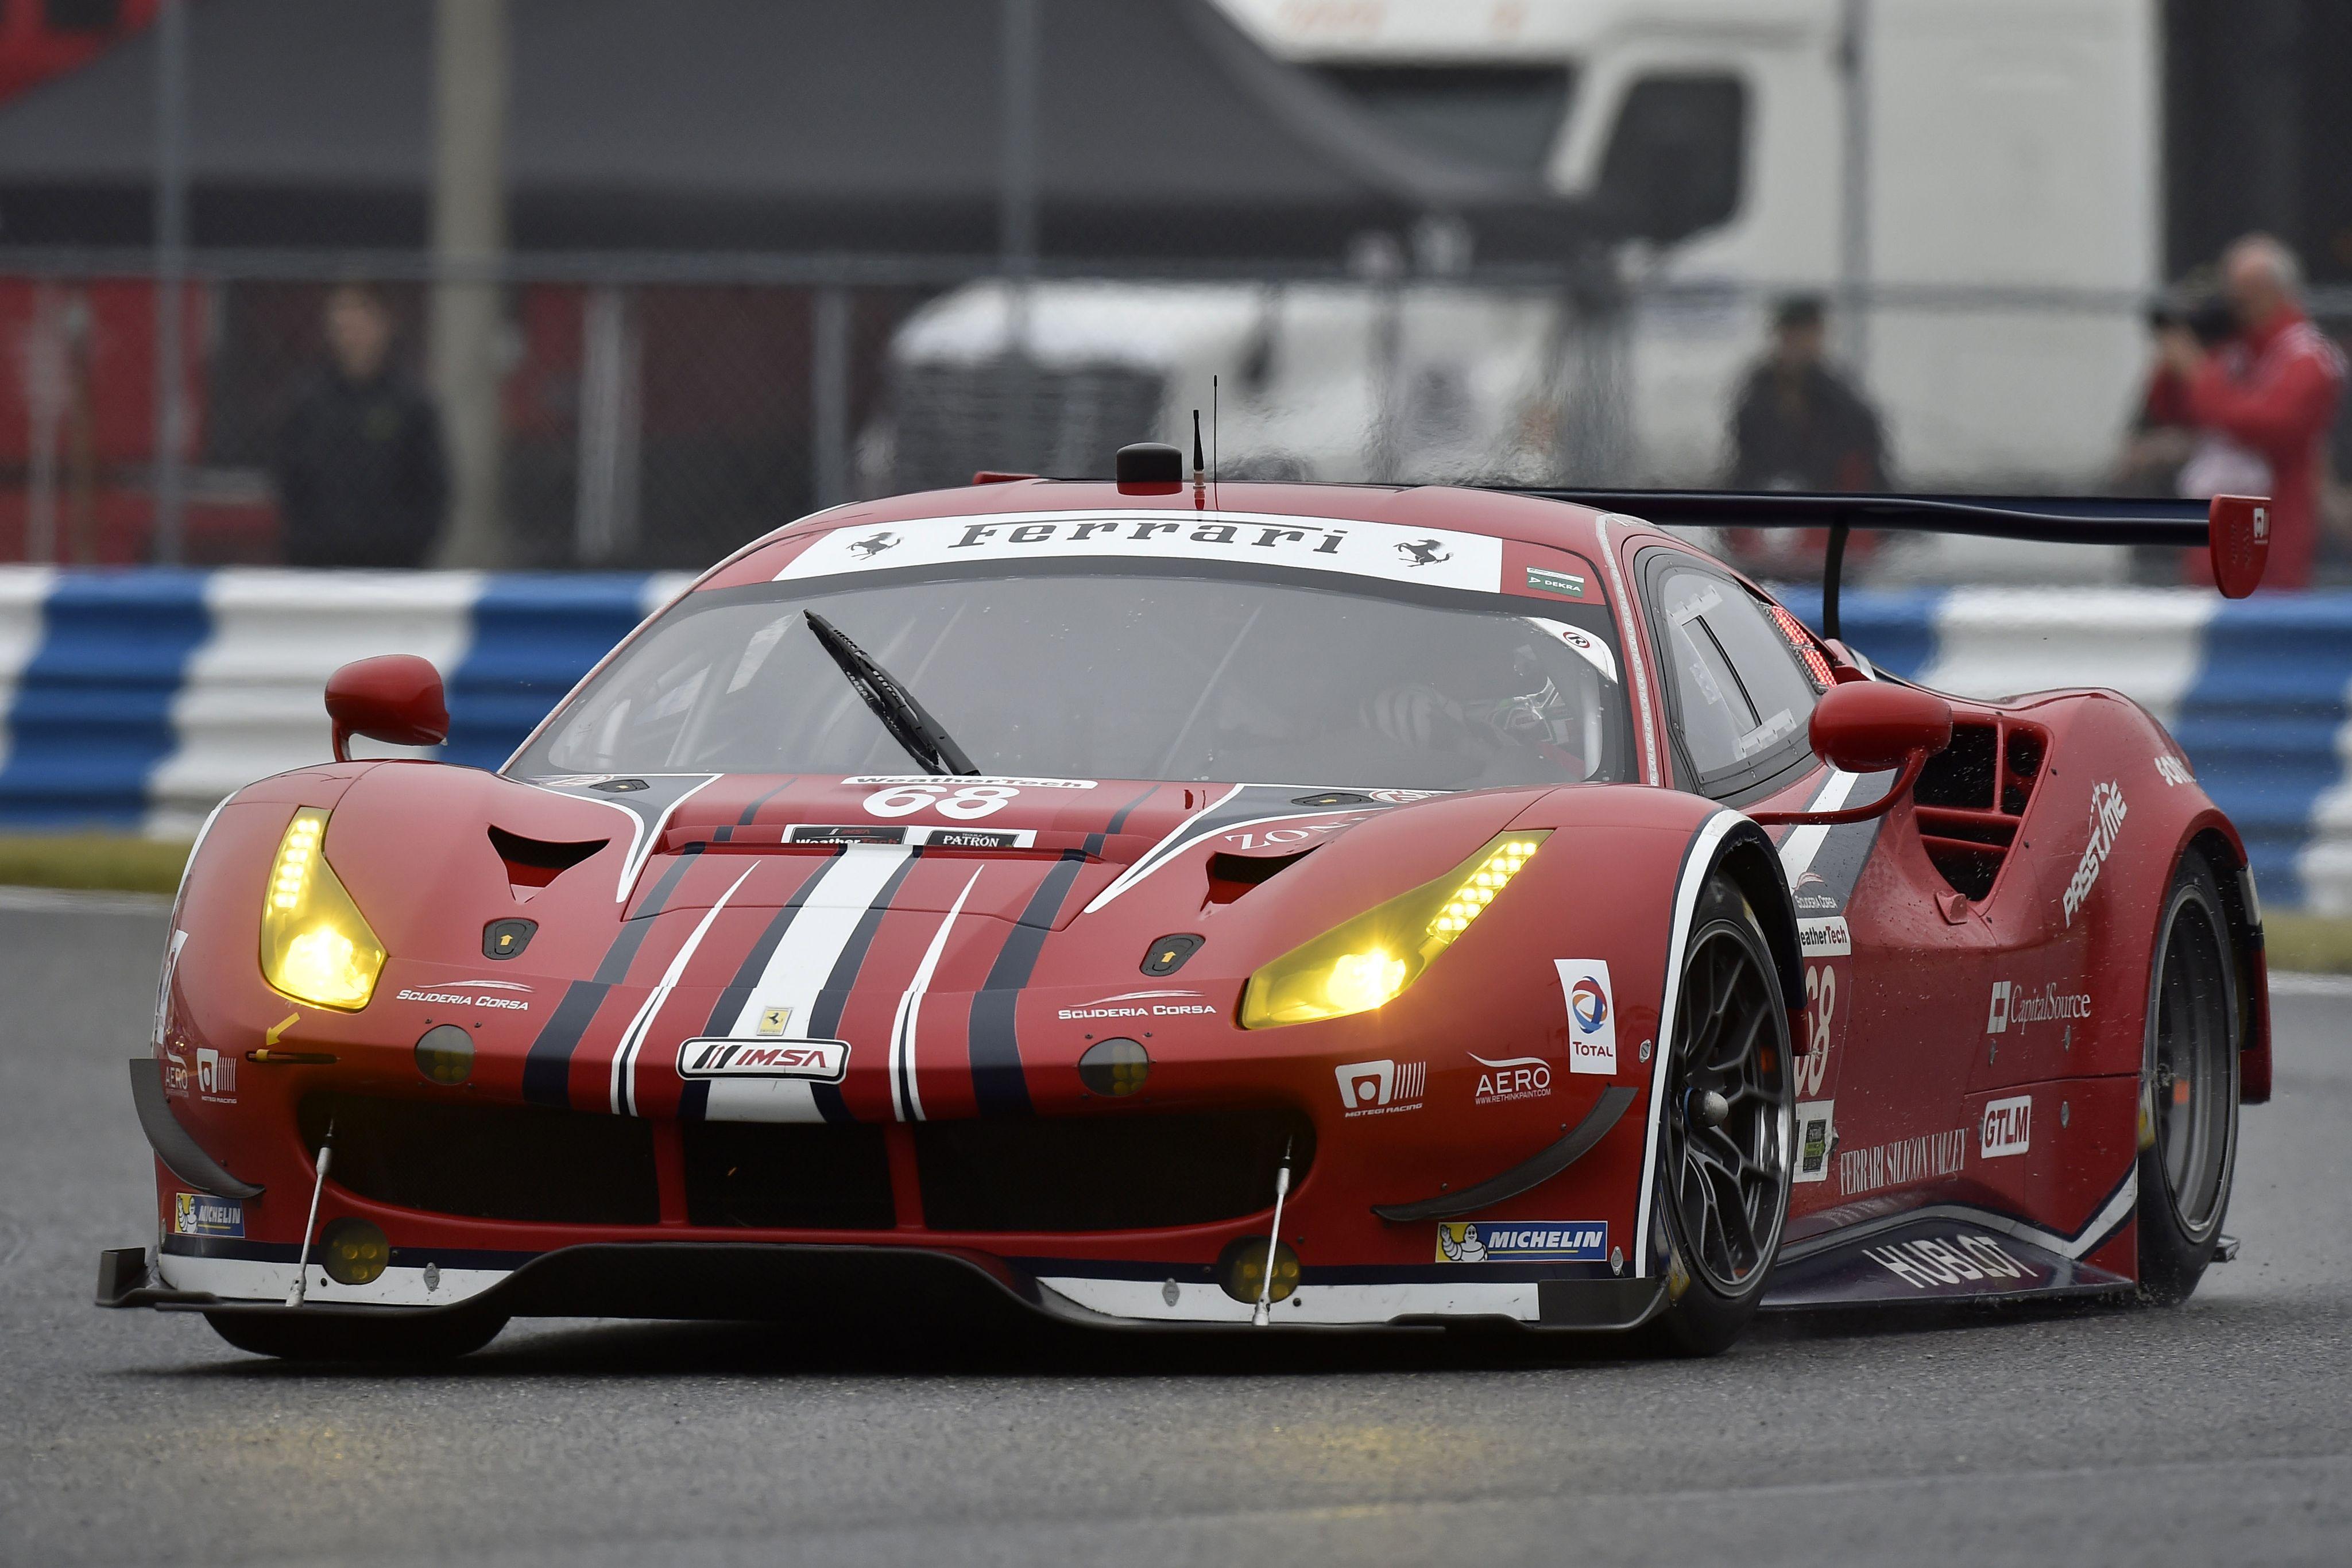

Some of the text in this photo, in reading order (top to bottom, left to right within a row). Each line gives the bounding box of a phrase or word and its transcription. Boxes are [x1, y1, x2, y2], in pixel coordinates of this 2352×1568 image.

[947, 518, 1349, 555] Ferrari
[1545, 580, 1581, 591] DEKRA
[857, 777, 1082, 787] WeatherTech
[862, 785, 1020, 820] 68
[943, 835, 1000, 847] PATRÓN
[1800, 925, 1847, 946] eatherTech
[396, 989, 528, 1011] SCUDERIA CORSA
[2011, 982, 2091, 1035] CapitalSource
[1058, 1005, 1216, 1020] SCUDERIA CORSA
[735, 1049, 827, 1068] IMSA
[1572, 1041, 1614, 1058] TOTAL
[165, 1066, 188, 1090] AERO
[1475, 1067, 1550, 1097] AERO
[1475, 1089, 1551, 1105] WWW.RETHINKPAINT.COM
[1345, 1103, 1423, 1118] MOTEGI RACING
[1984, 1105, 2029, 1148] GTLM
[1840, 1145, 1885, 1196] FERRARI
[1887, 1135, 1929, 1186] SILICON
[1931, 1128, 1969, 1177] VALLEY
[198, 1205, 240, 1224] MICHELIN
[1488, 1230, 1603, 1248] MICHELIN
[1862, 1233, 2038, 1288] HUBLOT
